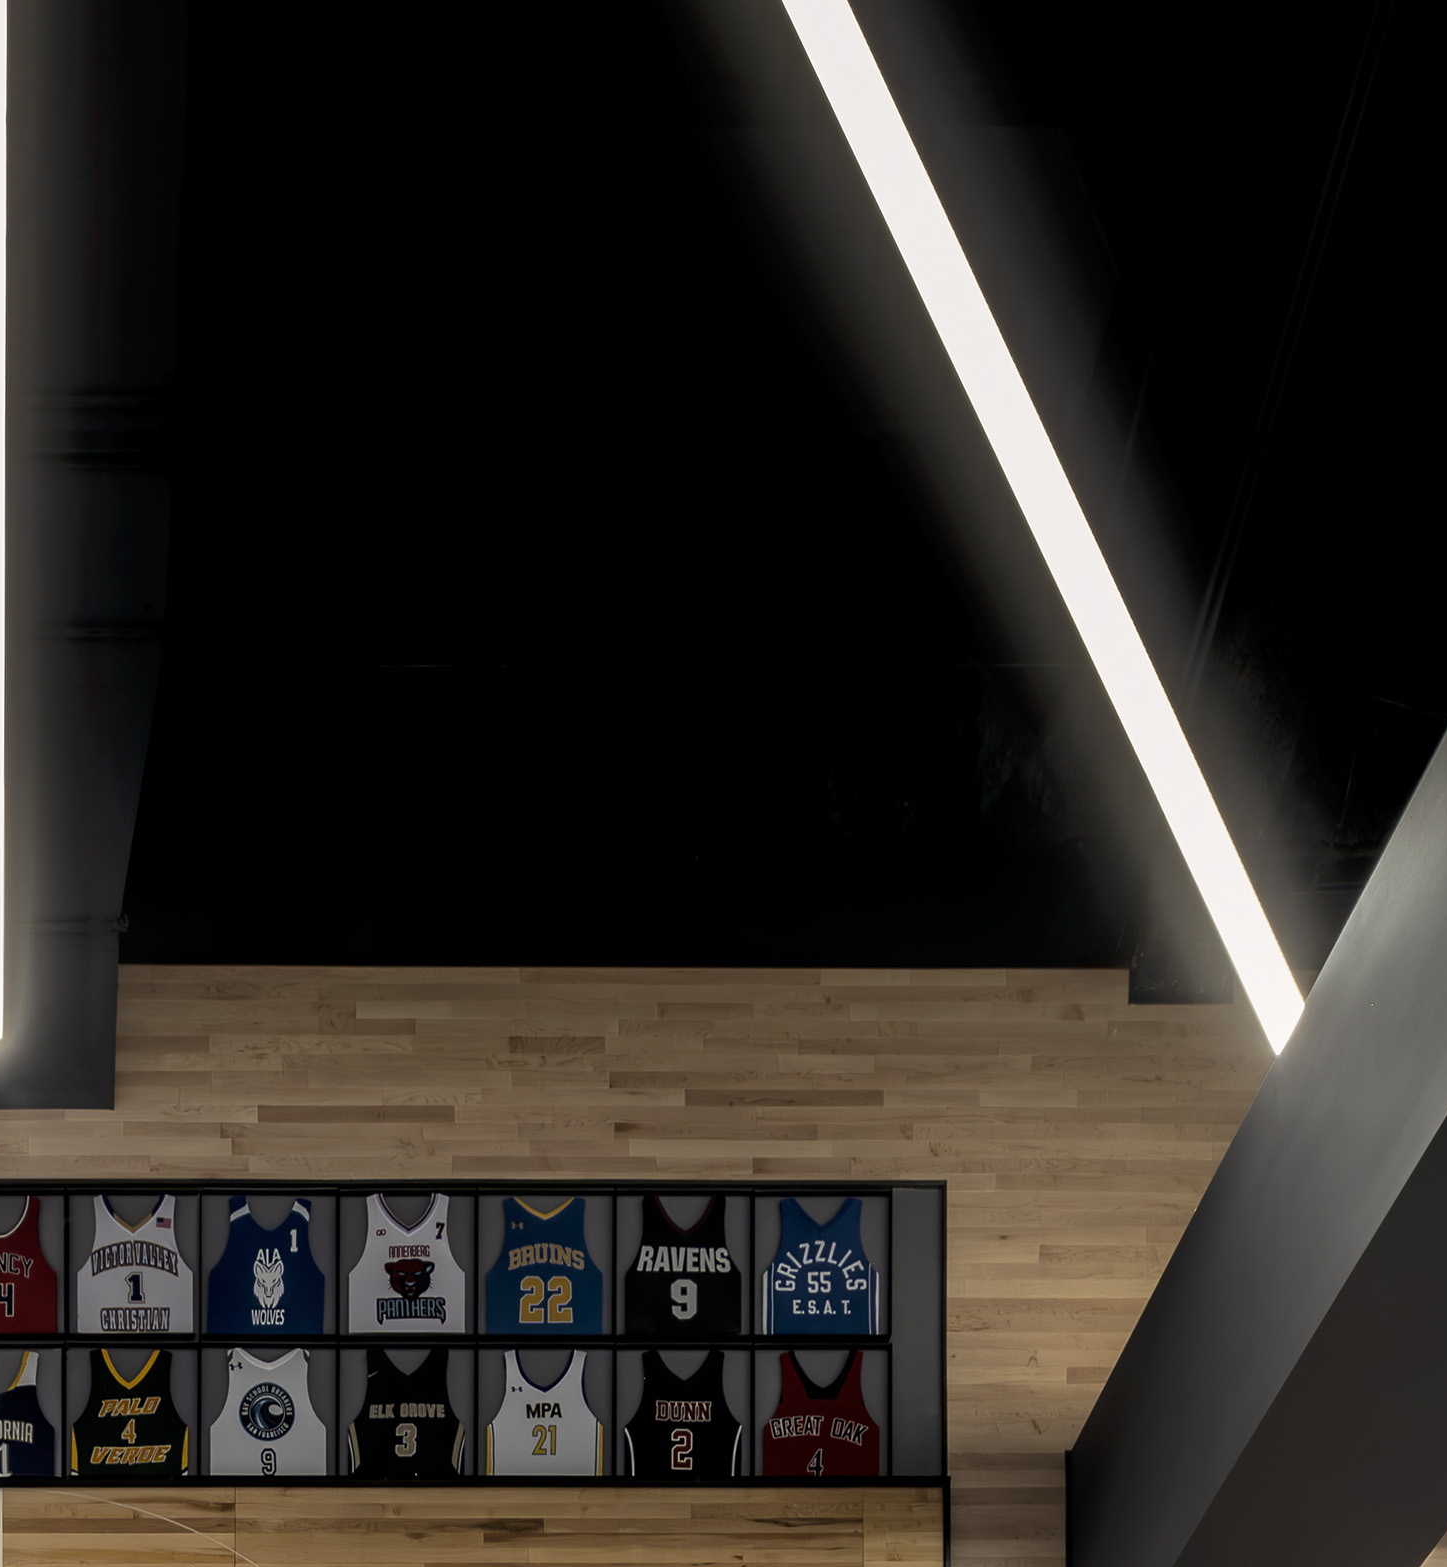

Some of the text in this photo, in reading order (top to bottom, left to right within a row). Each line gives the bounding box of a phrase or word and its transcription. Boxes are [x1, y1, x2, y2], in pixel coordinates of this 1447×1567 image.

[508, 1242, 585, 1271] BRUINS
[635, 1245, 731, 1274] RAVENS
[775, 1241, 867, 1292] GRIZZLIES
[807, 1271, 832, 1294] 55
[375, 1297, 447, 1324] PANTHERS
[519, 1275, 572, 1324] 22
[669, 1278, 698, 1320] 9
[250, 1308, 285, 1326] WOLVES
[98, 1396, 161, 1417] PALO
[368, 1401, 445, 1420] ELK GROVE
[525, 1402, 561, 1420] MPA
[655, 1400, 711, 1422] DUNN
[531, 1425, 557, 1455] 21
[768, 1416, 867, 1446] GREAT OAK
[90, 1444, 170, 1465] VERDE
